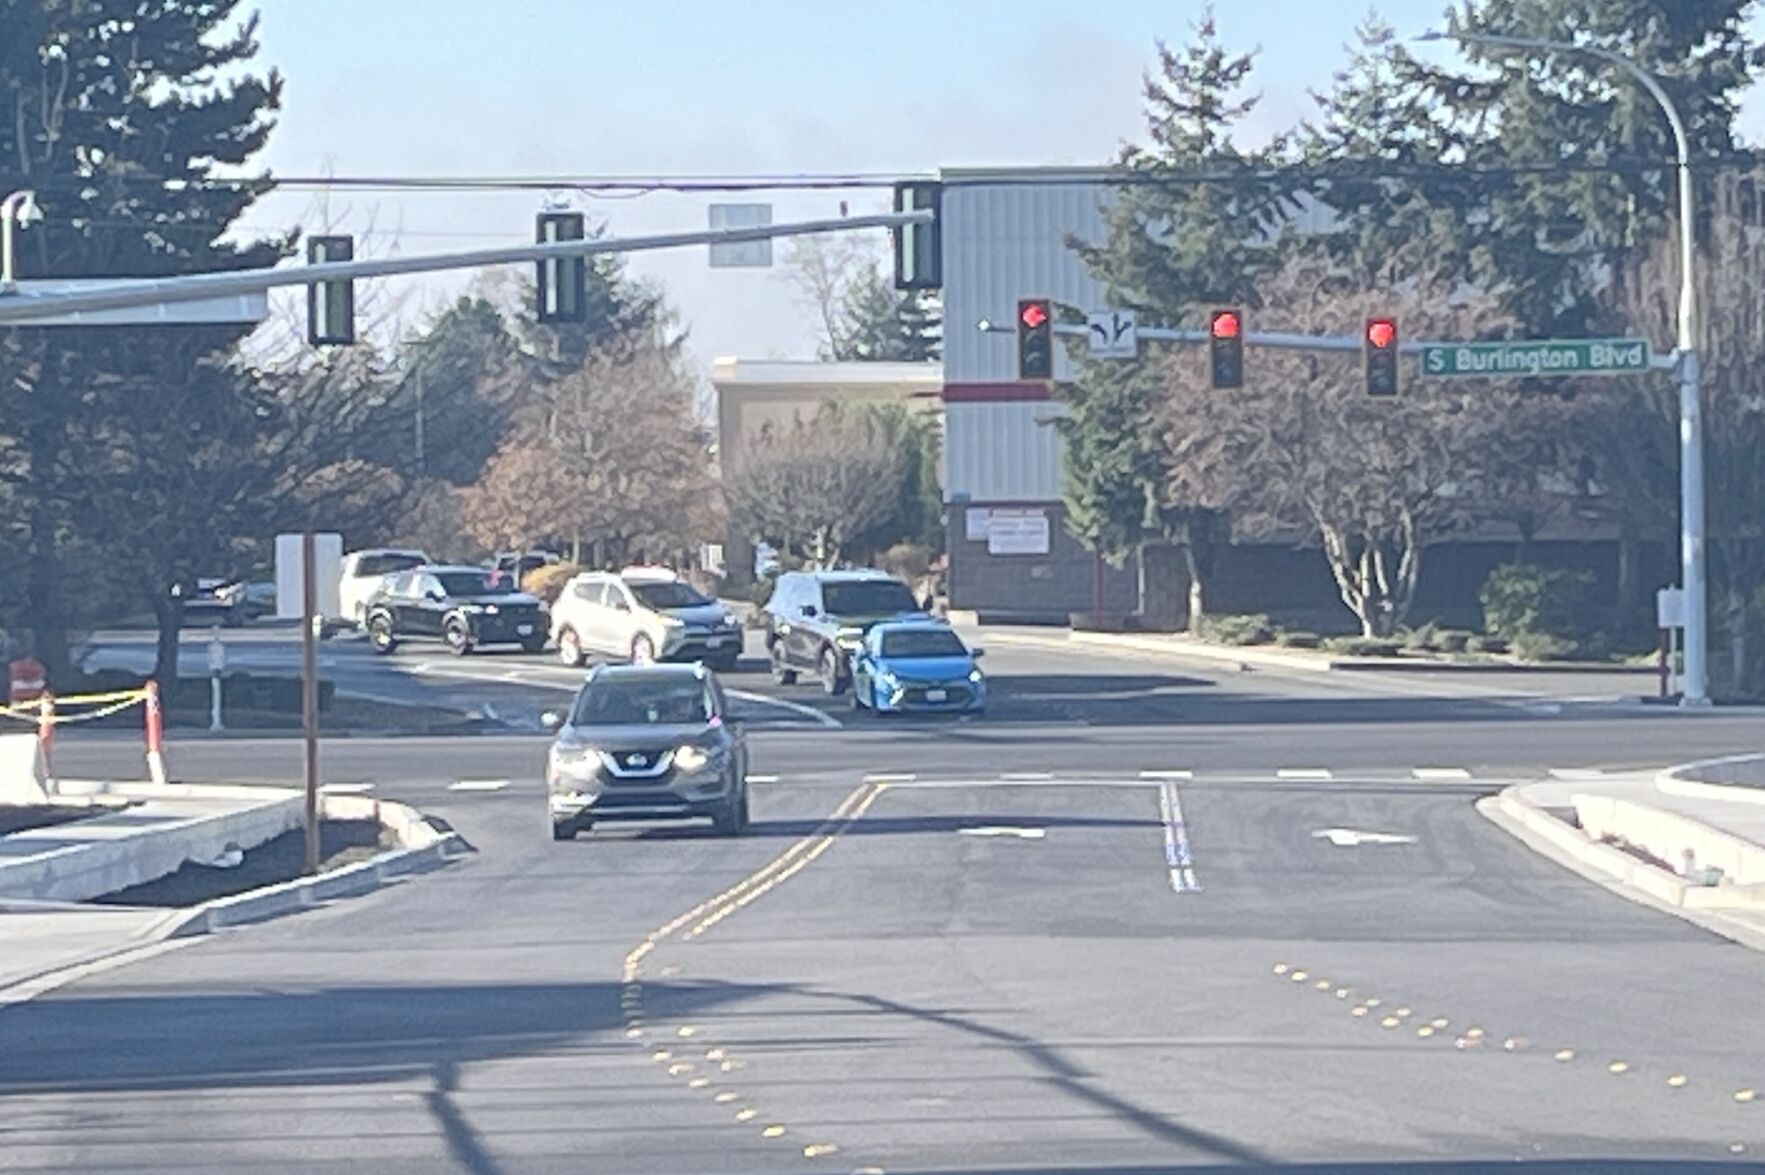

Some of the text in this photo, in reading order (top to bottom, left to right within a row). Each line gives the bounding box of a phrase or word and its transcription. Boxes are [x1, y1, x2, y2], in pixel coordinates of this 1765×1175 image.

[1428, 344, 1643, 374] S Burlington Blvd
